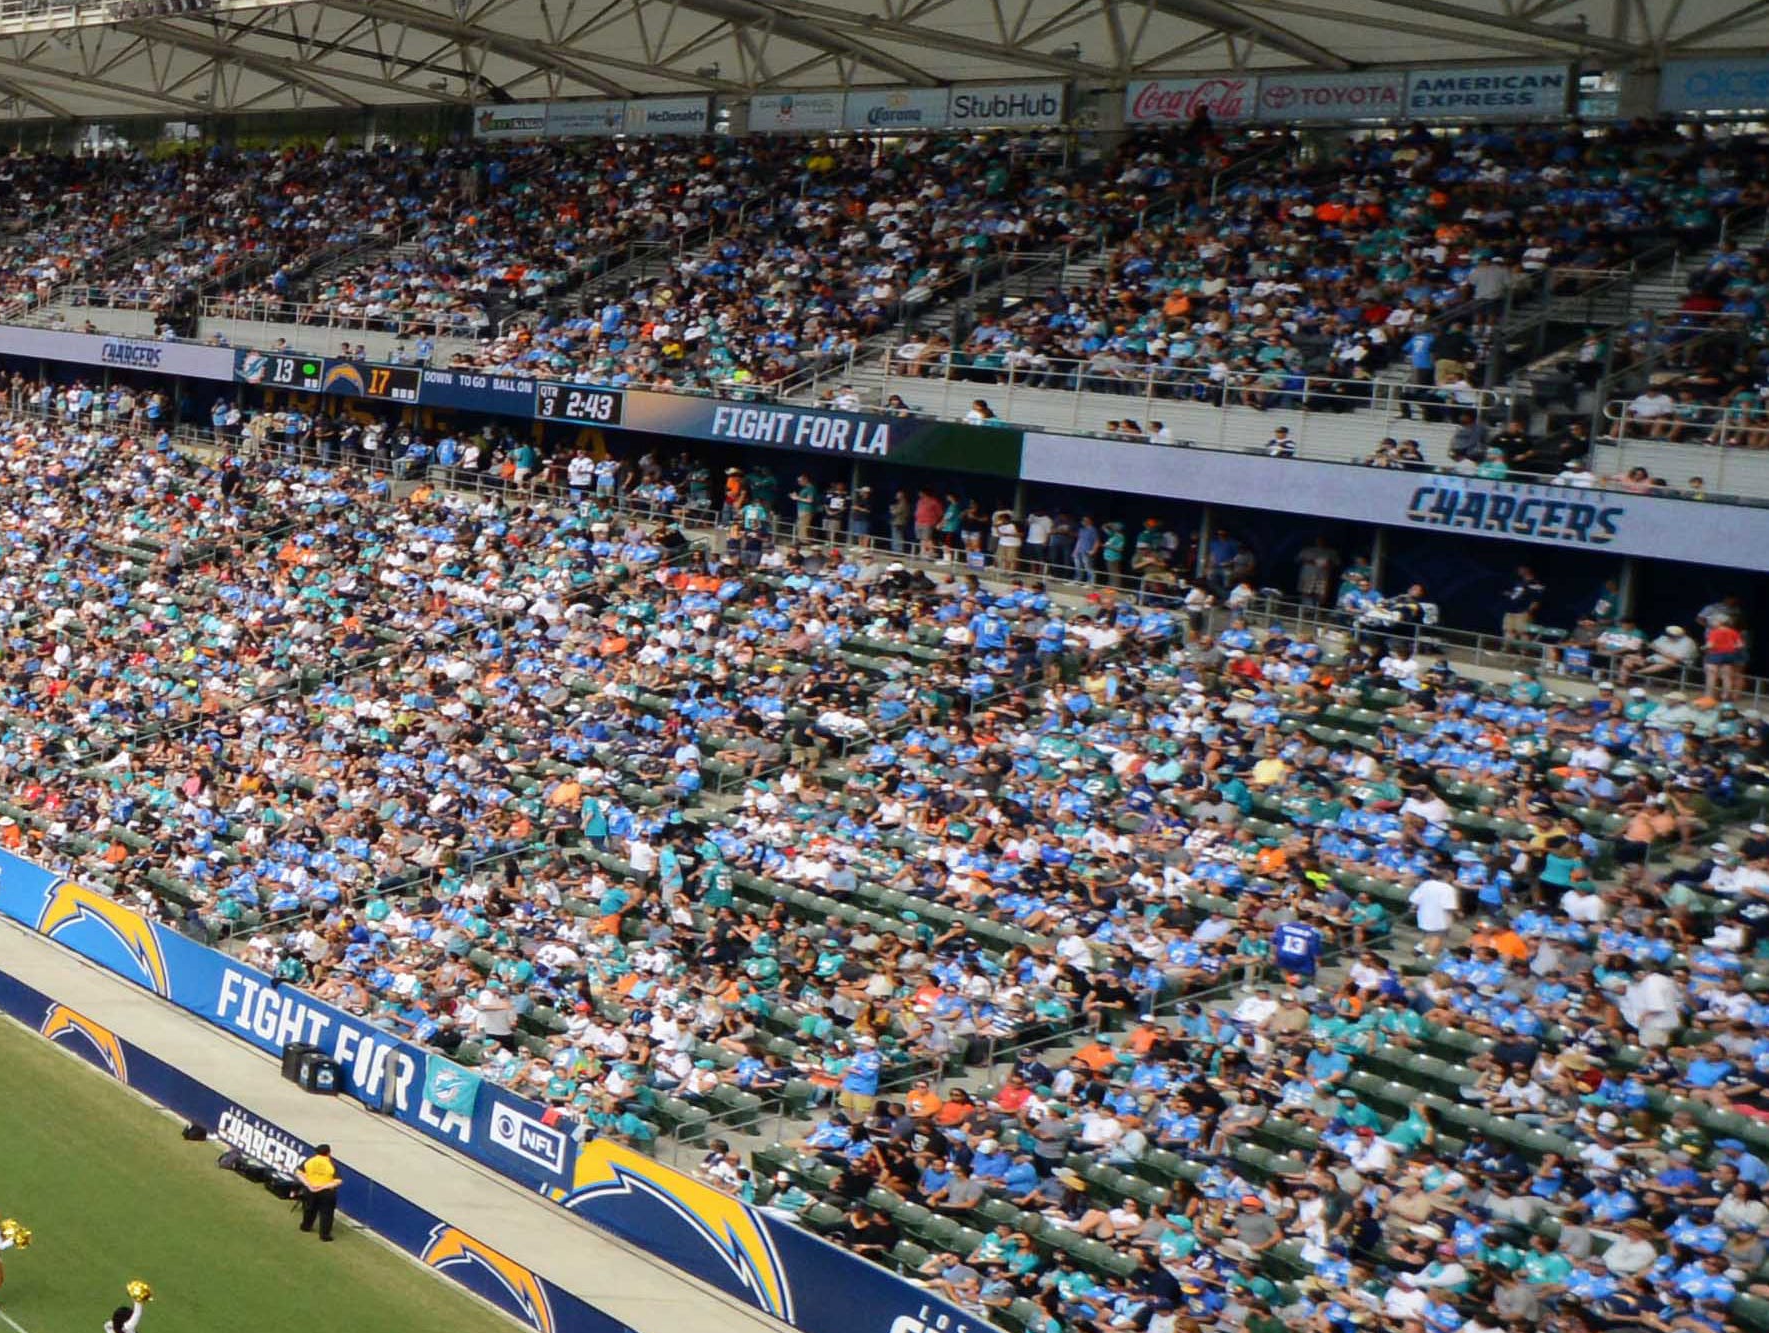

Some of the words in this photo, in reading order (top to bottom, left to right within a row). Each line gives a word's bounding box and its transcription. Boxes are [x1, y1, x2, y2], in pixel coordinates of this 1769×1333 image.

[1414, 73, 1564, 91] AMERICAN
[953, 92, 1056, 119] StubHub
[1301, 87, 1395, 105] TOYOTA
[1410, 91, 1536, 109] EXPRESS
[867, 106, 921, 125] Corona
[273, 358, 293, 383] 13
[370, 369, 390, 395] 17
[424, 371, 452, 385] DOWN
[541, 385, 559, 398] QTR
[543, 398, 553, 416] 3
[566, 392, 613, 420] 2:43
[711, 406, 793, 440] FIGHT
[795, 415, 848, 450] FOR
[853, 421, 890, 456] LA
[1405, 486, 1624, 545] CHARGERS
[217, 968, 331, 1058] FIGHT
[520, 1126, 559, 1161] NFL
